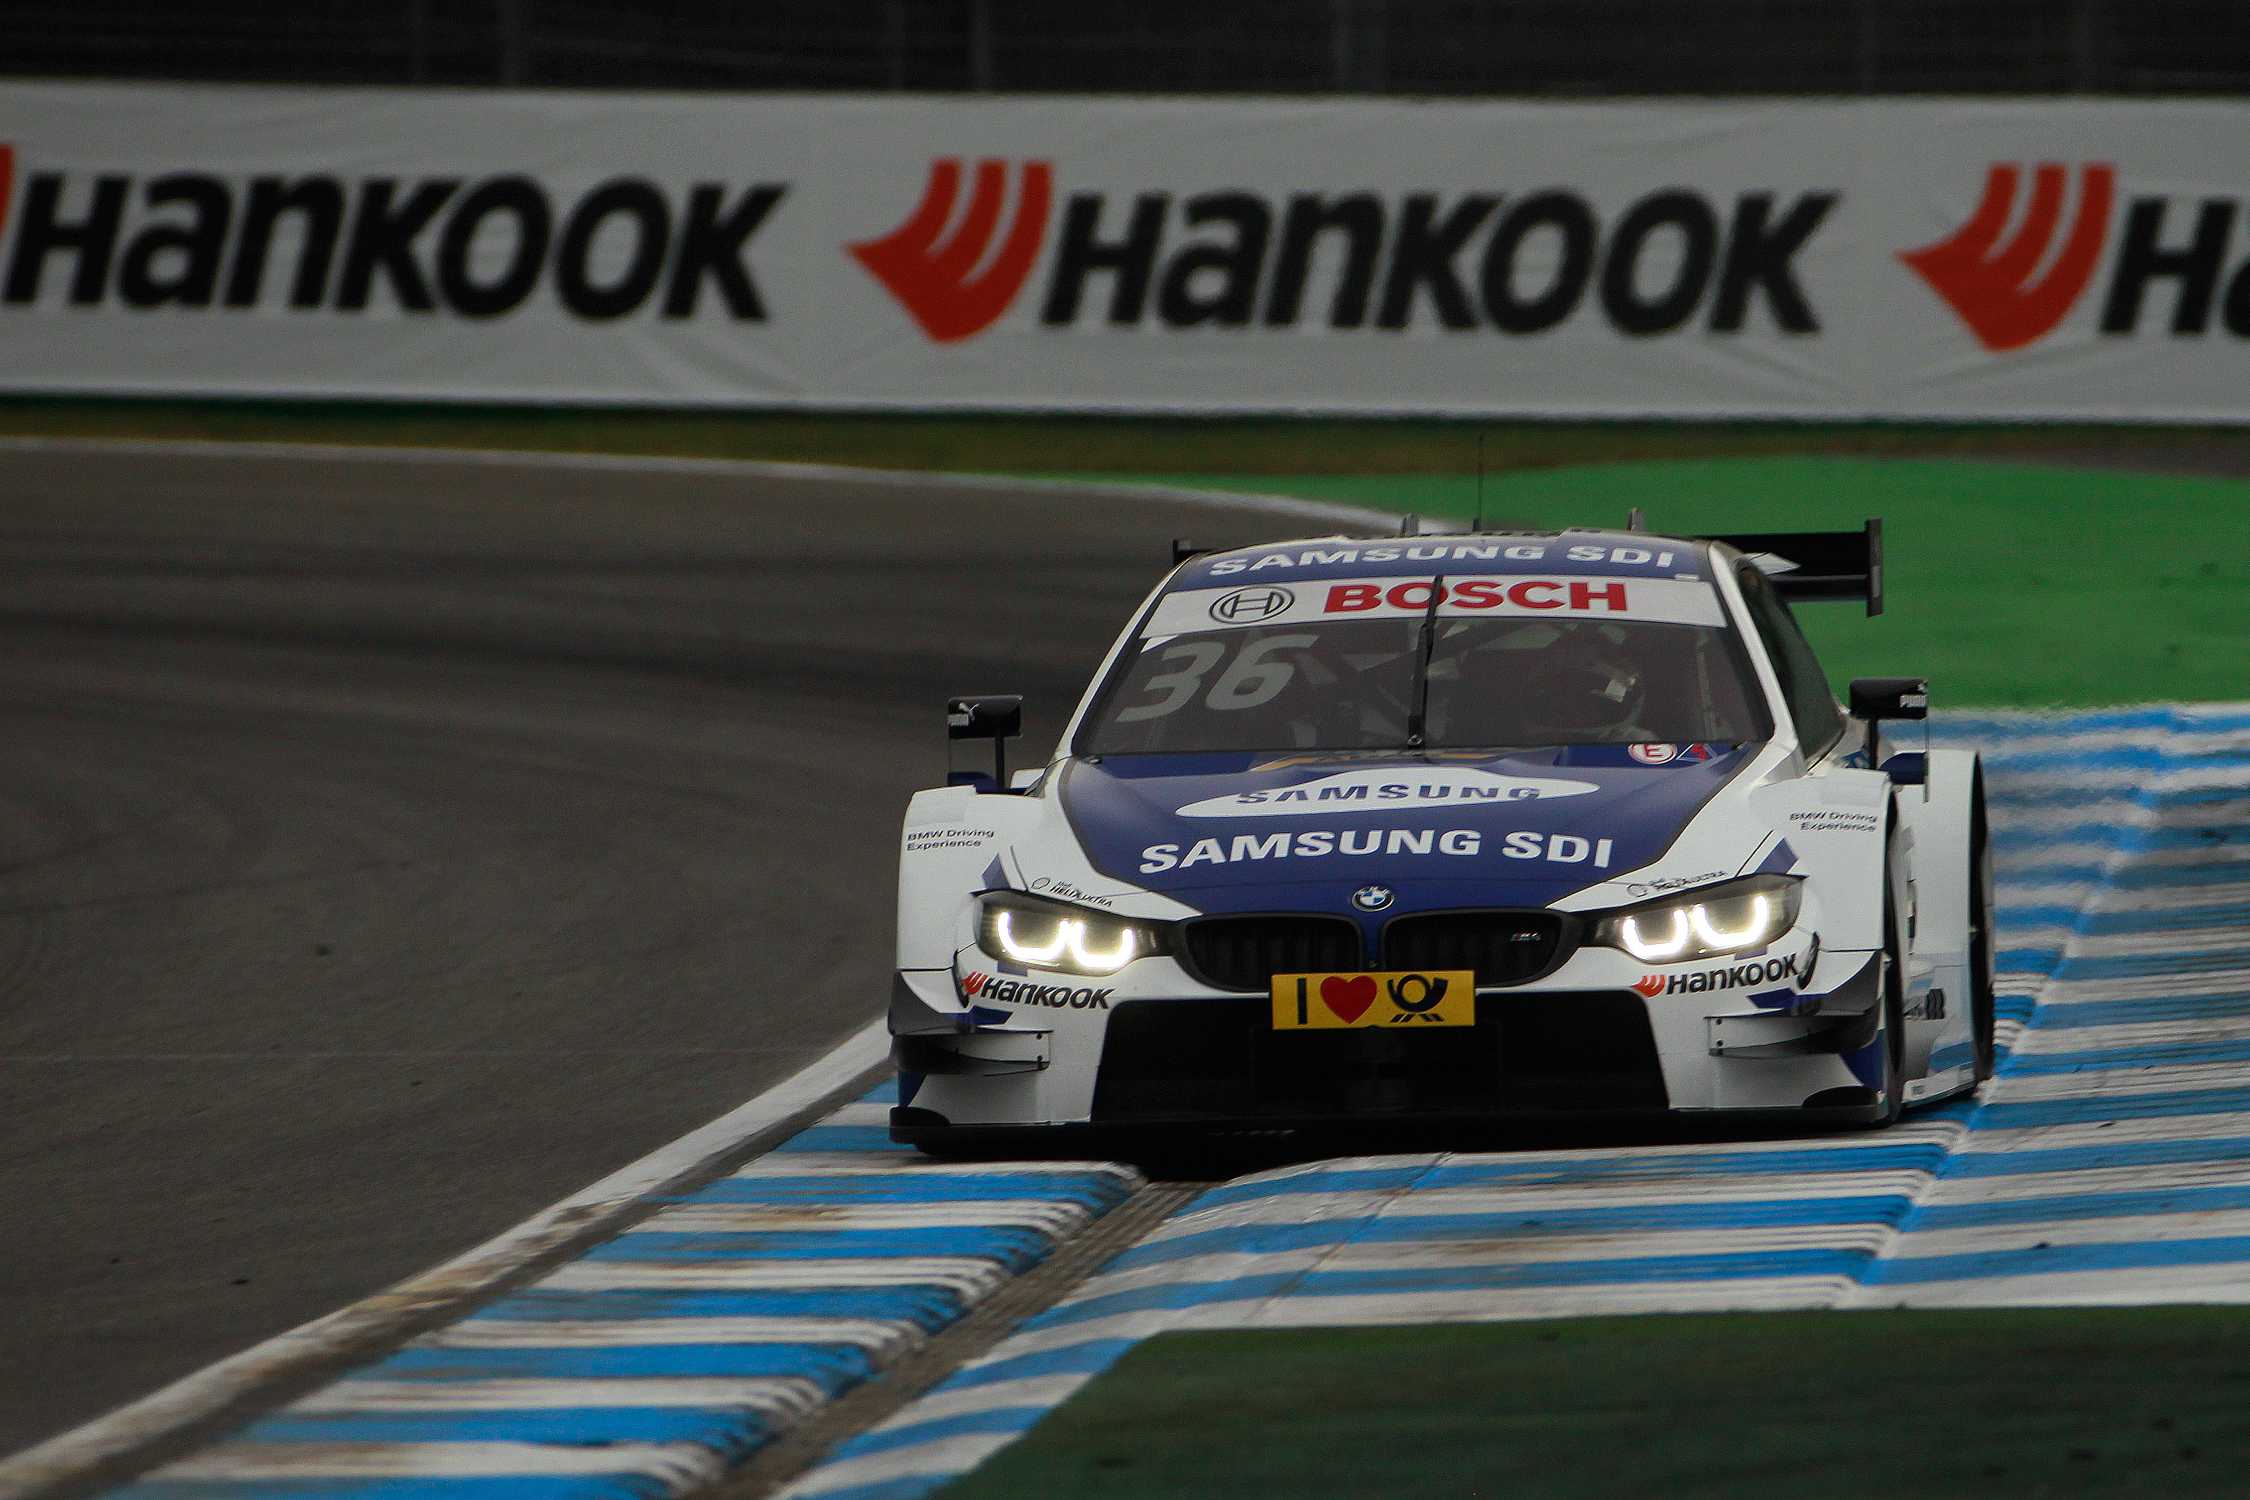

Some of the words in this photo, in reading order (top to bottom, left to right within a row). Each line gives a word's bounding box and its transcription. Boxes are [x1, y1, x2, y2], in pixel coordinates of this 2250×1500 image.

[1208, 545, 1545, 576] SAMSUNG
[1566, 545, 1675, 568] SDI
[1323, 580, 1628, 614] BOSCH
[1114, 633, 1321, 723] 36
[1236, 784, 1541, 804] SAMSUNG
[906, 839, 983, 852] Experience
[907, 830, 944, 842] BMW
[946, 829, 995, 839] Driving
[1139, 829, 1482, 875] SAMSUNG
[1502, 831, 1614, 868] SDI
[1296, 977, 1308, 1025] I
